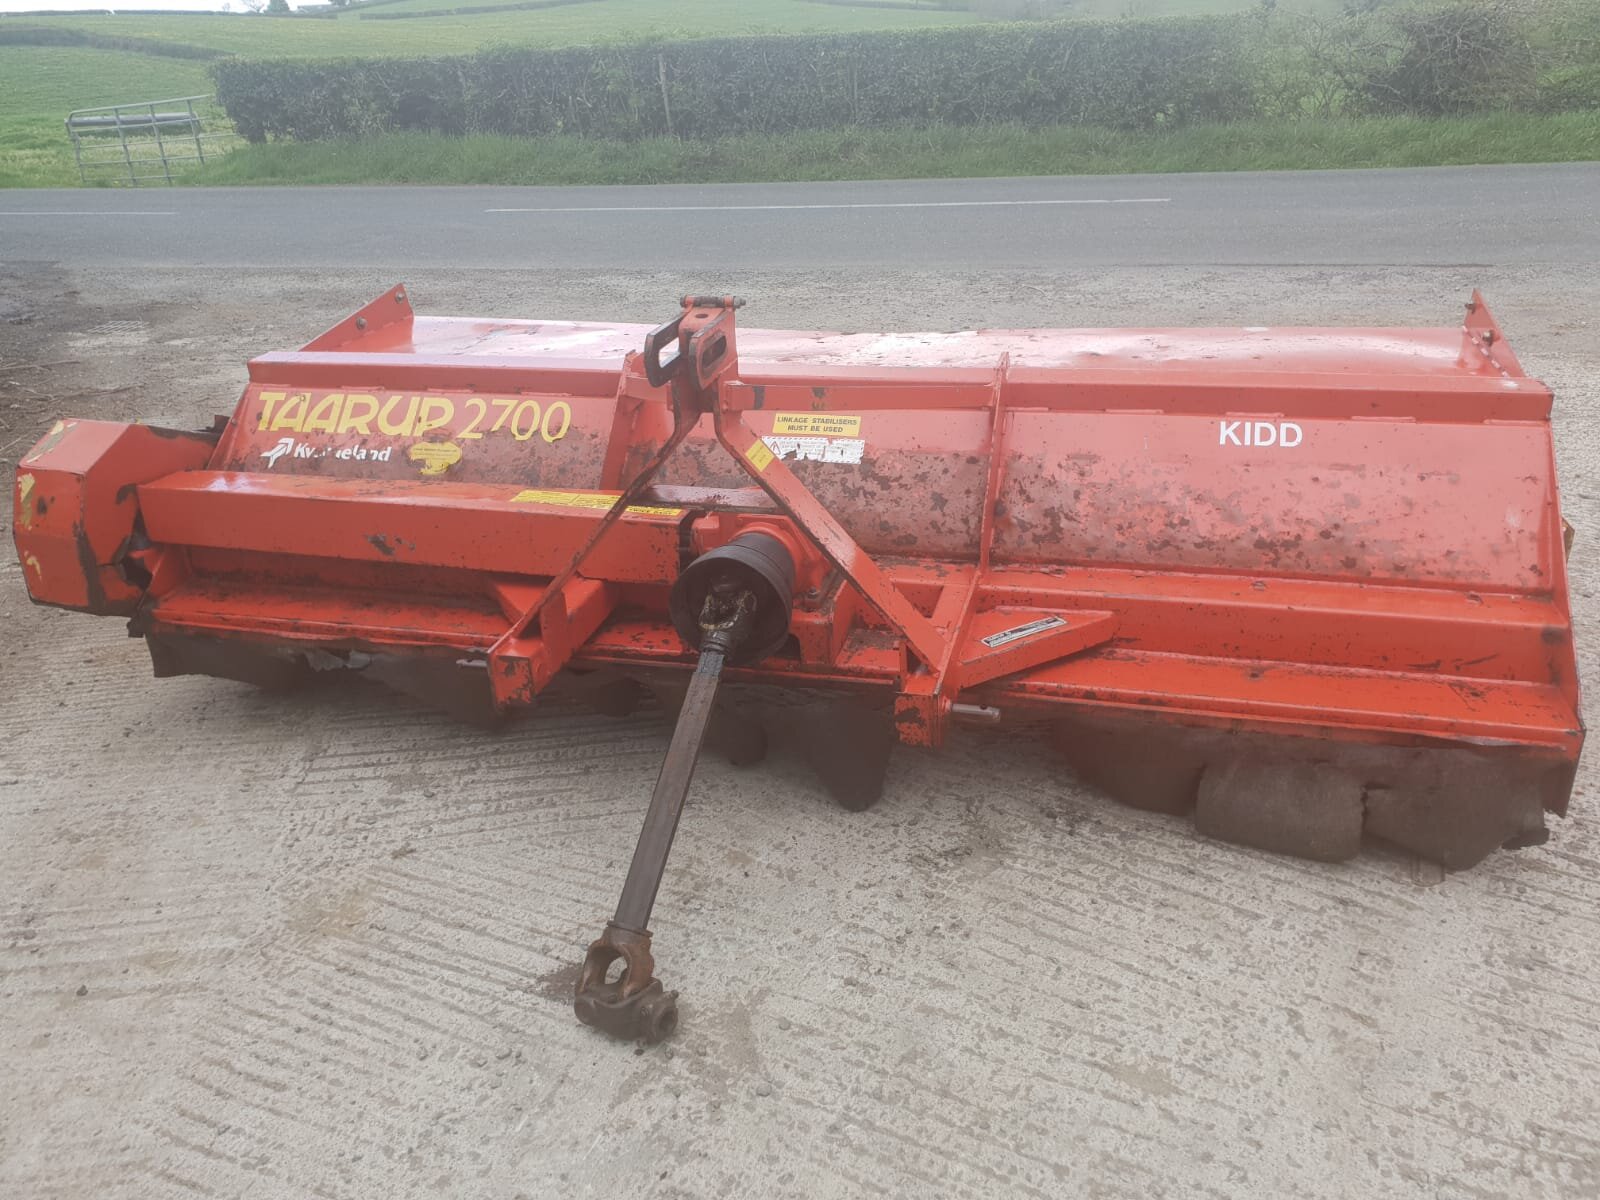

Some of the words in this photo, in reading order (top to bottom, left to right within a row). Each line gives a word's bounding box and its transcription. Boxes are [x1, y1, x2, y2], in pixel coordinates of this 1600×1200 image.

[258, 391, 454, 437] TAARUP
[456, 398, 571, 443] 2700
[777, 416, 808, 424] LINKAGE
[812, 417, 857, 426] STABILISERS
[1219, 420, 1303, 447] KIDD
